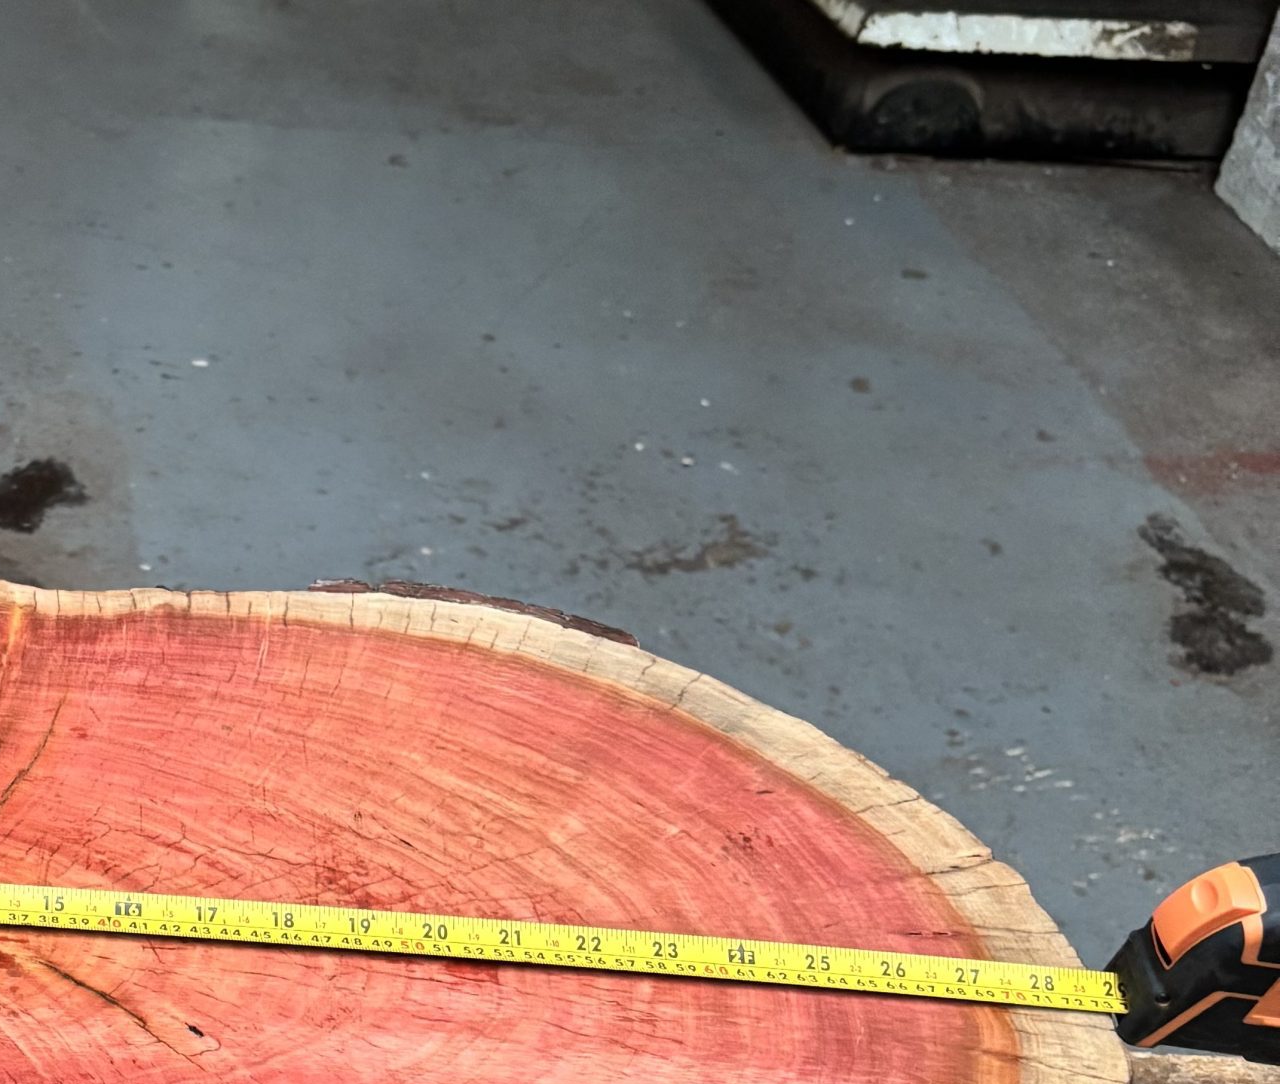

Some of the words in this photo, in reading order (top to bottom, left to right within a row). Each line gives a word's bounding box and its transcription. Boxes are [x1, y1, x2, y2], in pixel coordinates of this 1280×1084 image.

[9, 913, 28, 921] 37
[39, 915, 59, 924] 38
[69, 917, 89, 925] 39
[97, 918, 121, 928] 40
[129, 921, 148, 930] 41
[159, 923, 181, 932] 42
[190, 926, 211, 934] 43
[220, 928, 241, 936] 44
[250, 930, 271, 939] 45
[281, 932, 302, 941] 46
[311, 934, 331, 943] 47
[341, 937, 362, 945] 48
[371, 939, 393, 948] 49
[400, 940, 425, 950] 50
[433, 943, 452, 952] 51
[463, 946, 484, 955] 52
[494, 948, 515, 957] 53
[524, 951, 545, 959] 54
[554, 953, 575, 962] 55
[585, 956, 606, 965] 56
[615, 958, 635, 967] 57
[645, 961, 667, 970] 58
[676, 963, 697, 972] 59
[704, 965, 728, 975] 60
[736, 968, 755, 977] 61
[767, 971, 787, 980] 62
[797, 973, 818, 983] 63
[827, 976, 848, 985] 64
[857, 978, 878, 988] 65
[886, 981, 908, 990] 66
[916, 983, 935, 993] 67
[945, 986, 966, 996] 68
[975, 989, 995, 998] 69
[1001, 990, 1026, 1001] 70
[1032, 993, 1053, 1003] 71
[1061, 996, 1083, 1006] 72
[1090, 999, 1113, 1009] 73
[43, 895, 64, 911] 15
[115, 901, 142, 917] 16
[196, 906, 218, 922] 17
[272, 912, 294, 928] 18
[349, 917, 371, 933] 19
[422, 923, 448, 940] 20
[499, 929, 521, 945] 21
[576, 935, 601, 952] 22
[652, 941, 678, 958] 23
[805, 954, 830, 970] 25
[880, 960, 906, 977] 26
[955, 967, 980, 984] 27
[1029, 974, 1054, 991] 28
